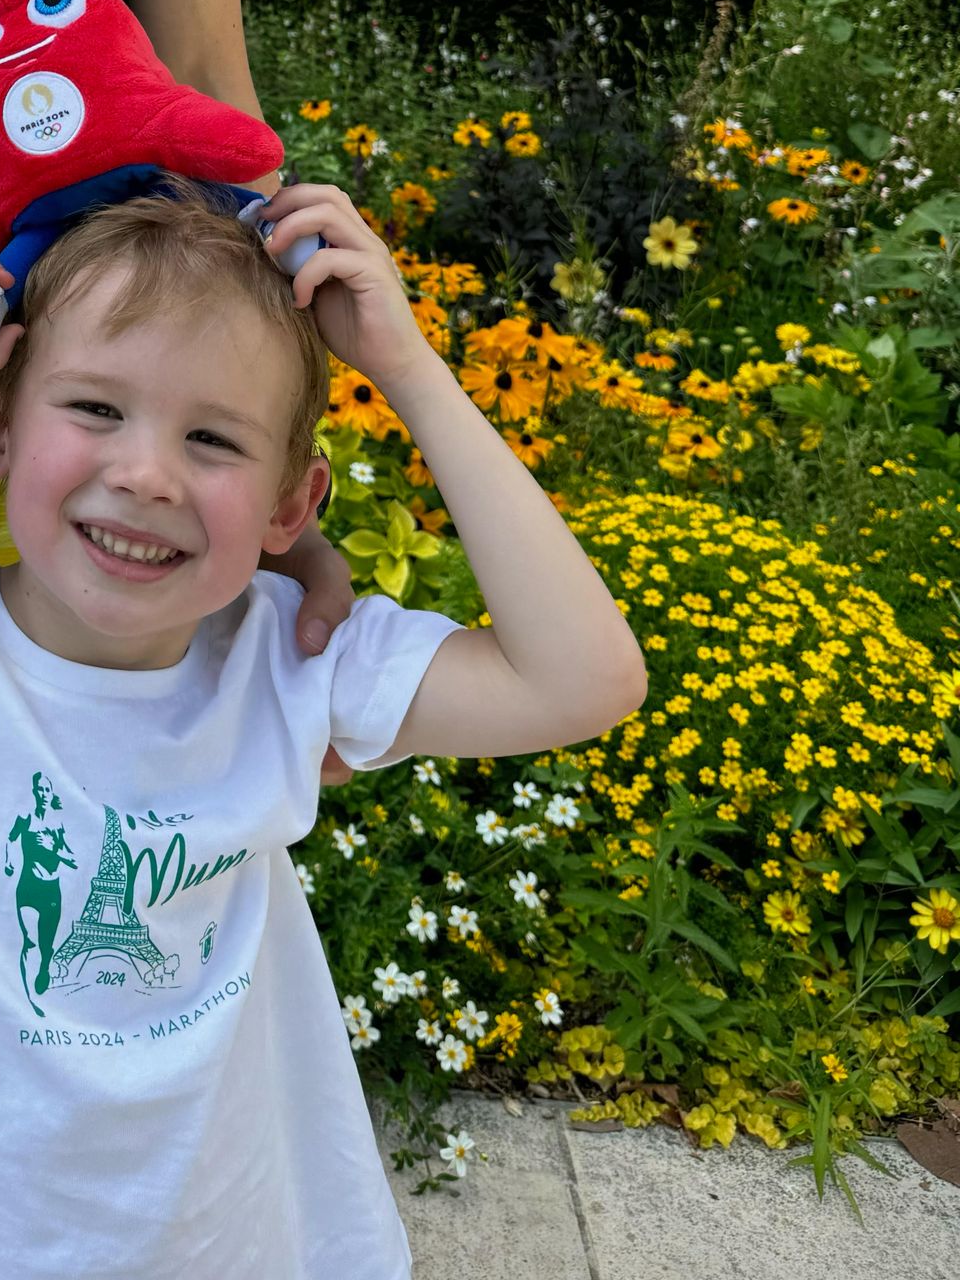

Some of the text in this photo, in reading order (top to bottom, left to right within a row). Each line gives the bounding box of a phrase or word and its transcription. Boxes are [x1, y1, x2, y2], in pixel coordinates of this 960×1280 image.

[46, 109, 70, 123] 2024
[117, 832, 256, 915] Mum
[95, 970, 126, 987] 2024
[19, 1029, 73, 1046] PARIS
[78, 1031, 125, 1047] 2024
[148, 971, 252, 1041] MARATHON
